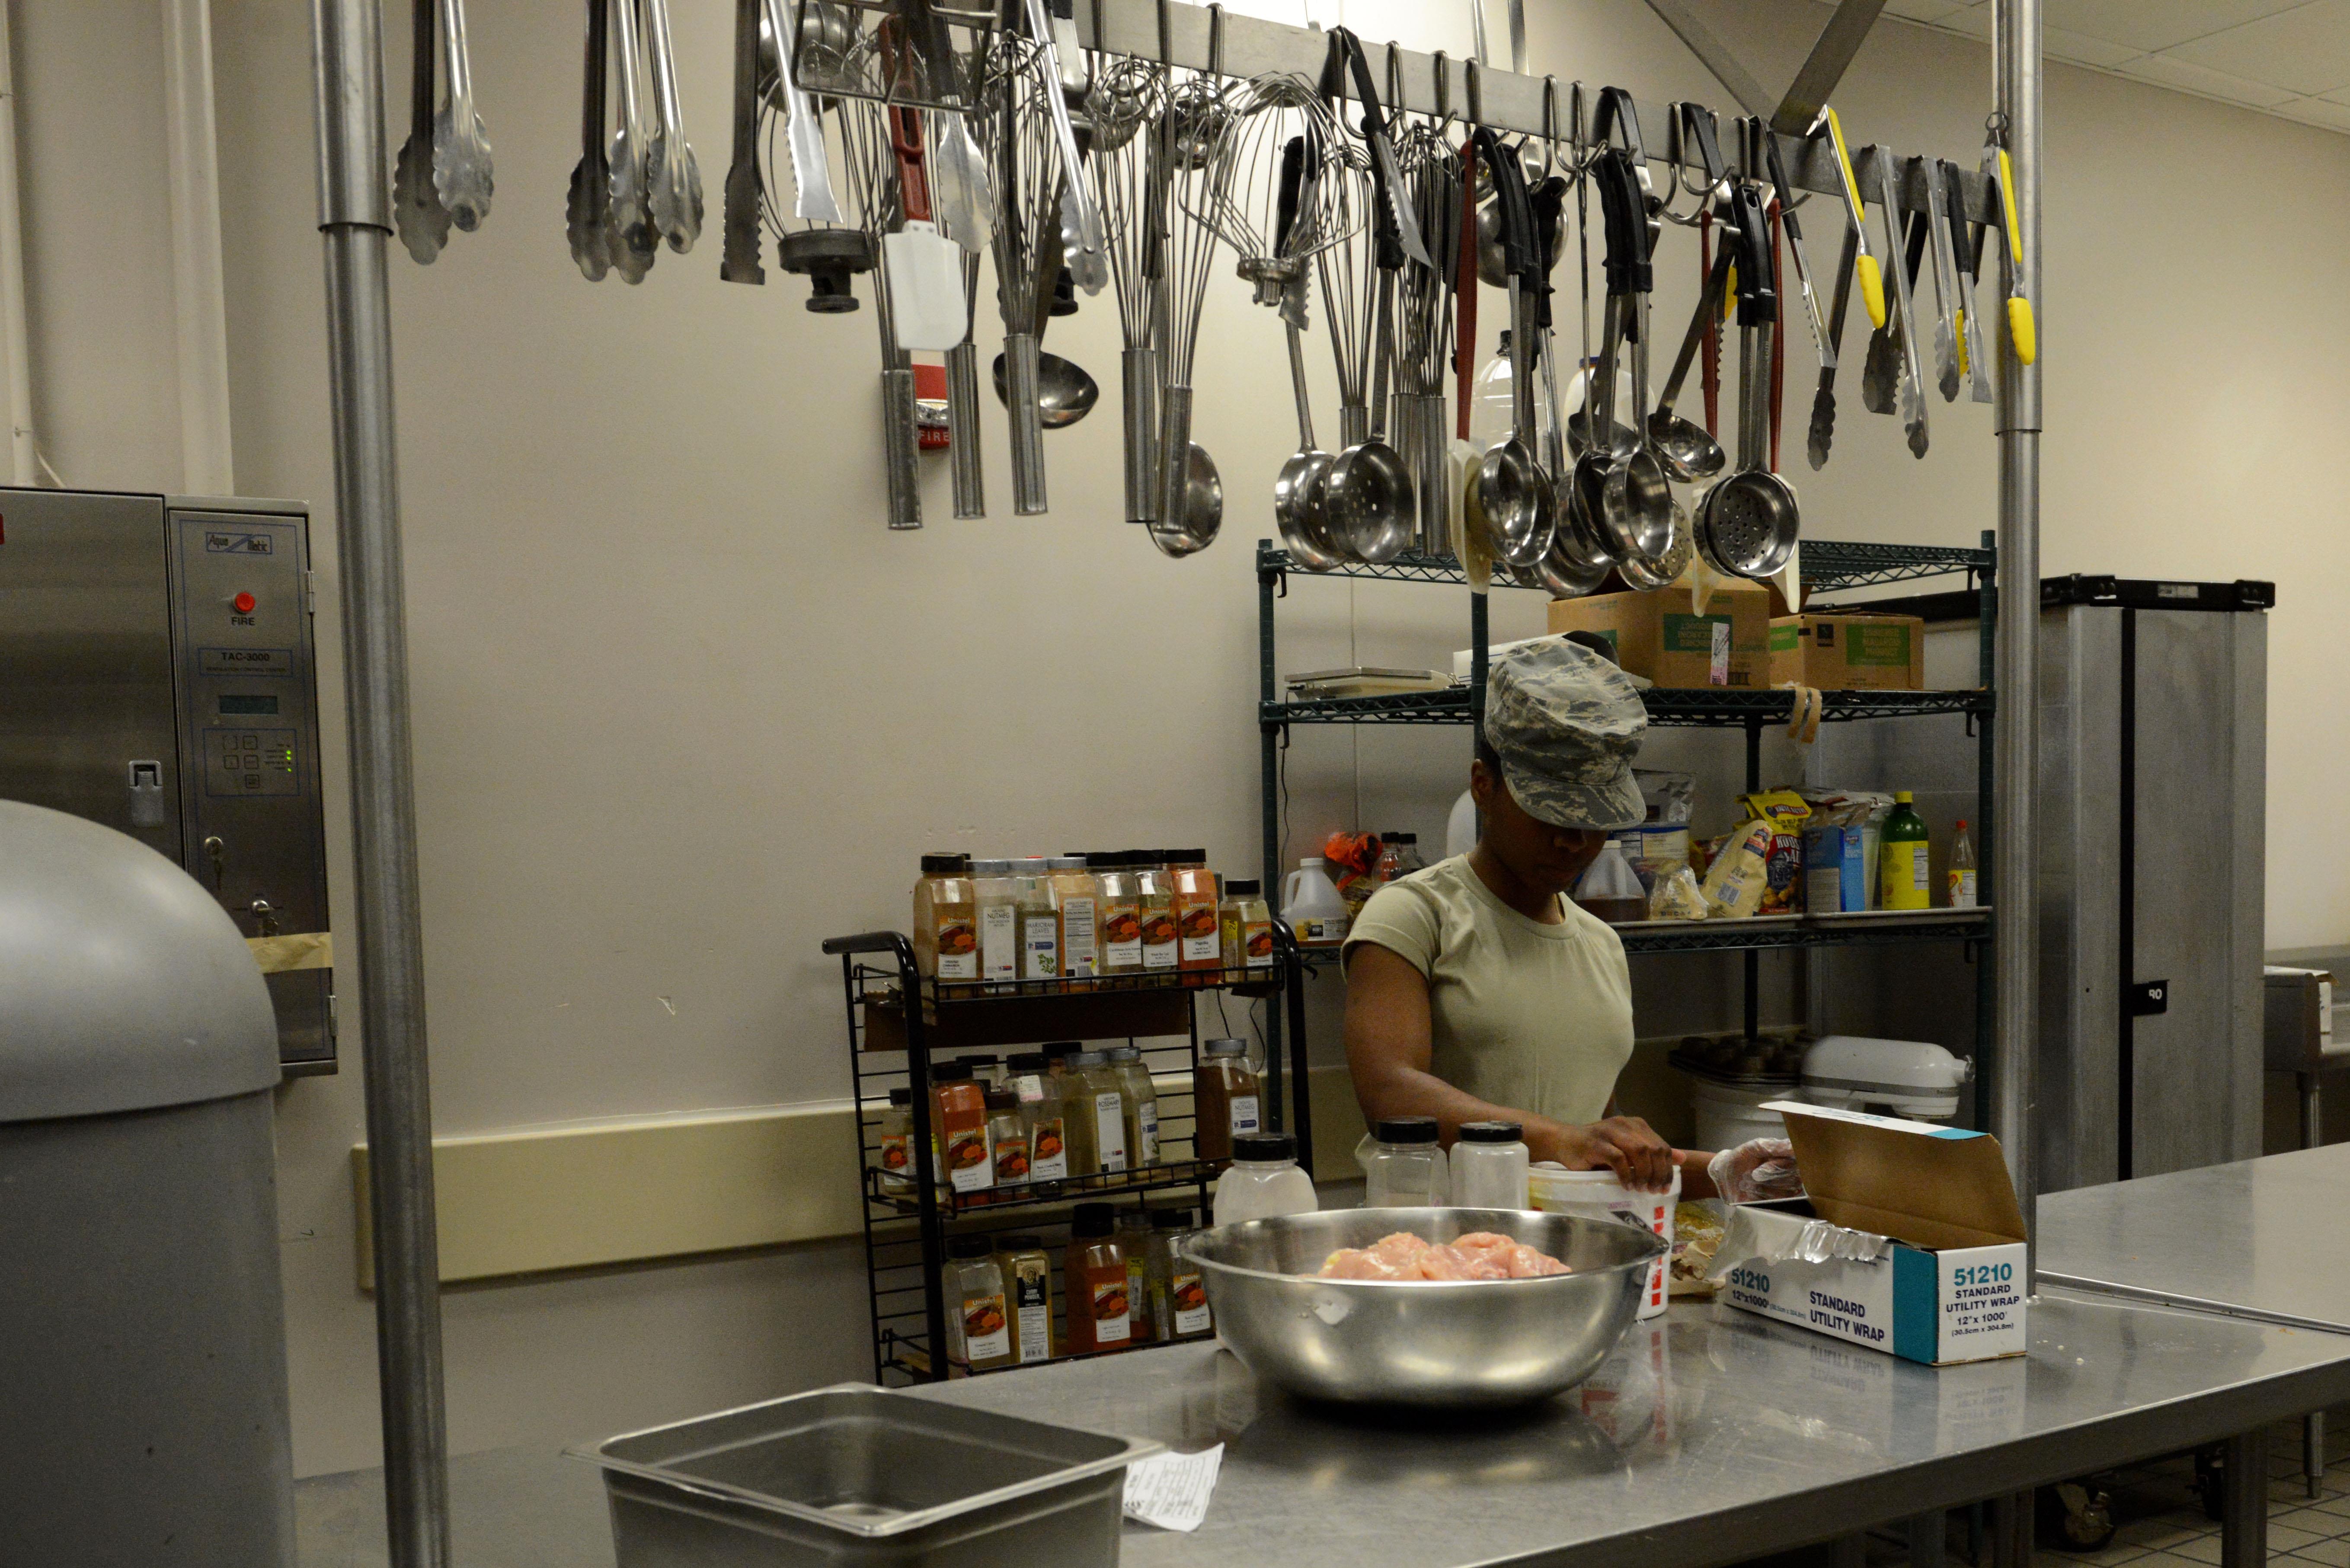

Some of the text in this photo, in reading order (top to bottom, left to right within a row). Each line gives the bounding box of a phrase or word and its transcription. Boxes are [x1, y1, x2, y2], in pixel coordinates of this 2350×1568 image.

[917, 430, 950, 441] FIRE
[231, 617, 256, 626] FIRE
[221, 652, 270, 661] TAC-3000
[953, 1128, 977, 1138] Unistel
[1732, 1268, 1770, 1293] 51210
[1953, 1263, 2012, 1287] 51210
[1955, 1284, 2011, 1299] STANDARD
[972, 1297, 996, 1306] Unistel
[1810, 1291, 1865, 1318] STANDARD
[1946, 1296, 2020, 1313] UTILITY WRAP
[1982, 1311, 2008, 1322] 1000'
[1810, 1309, 1885, 1342] UTILITY WRAP
[1952, 1328, 1979, 1337] (30.5cm
[1987, 1323, 2014, 1332] 304.8m)
